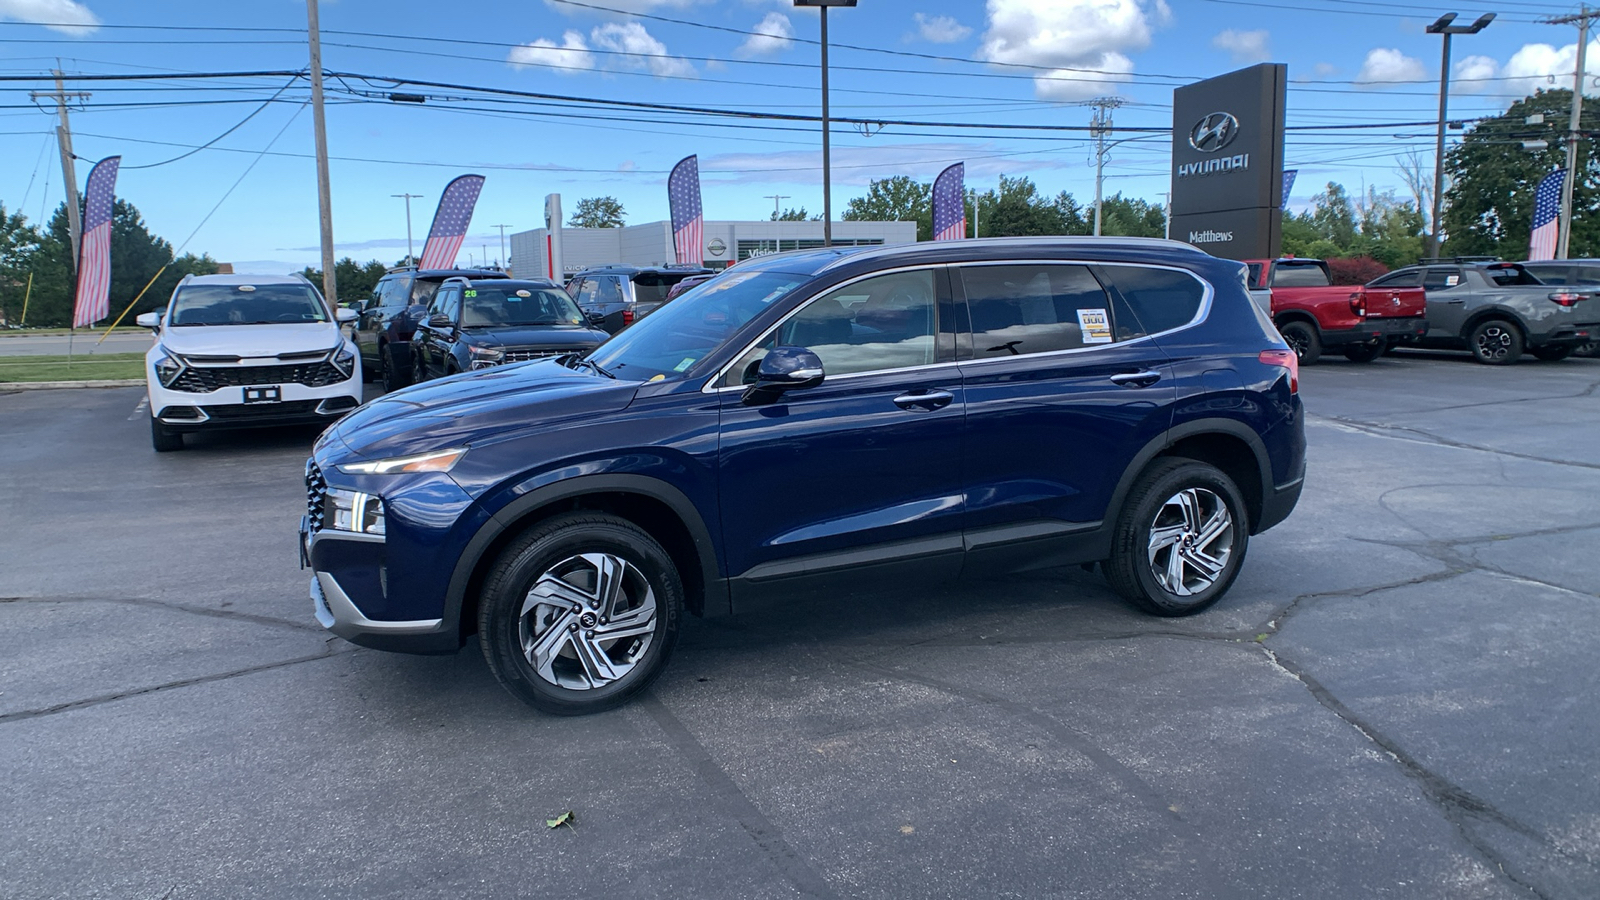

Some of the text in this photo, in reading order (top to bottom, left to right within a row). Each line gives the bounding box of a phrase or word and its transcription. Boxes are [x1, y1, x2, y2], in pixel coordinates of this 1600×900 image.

[1178, 154, 1249, 177] HYUNDAI
[1190, 230, 1233, 243] Matthews
[748, 248, 779, 258] Visio
[465, 290, 477, 298] 26
[660, 572, 676, 620] KUMHO
